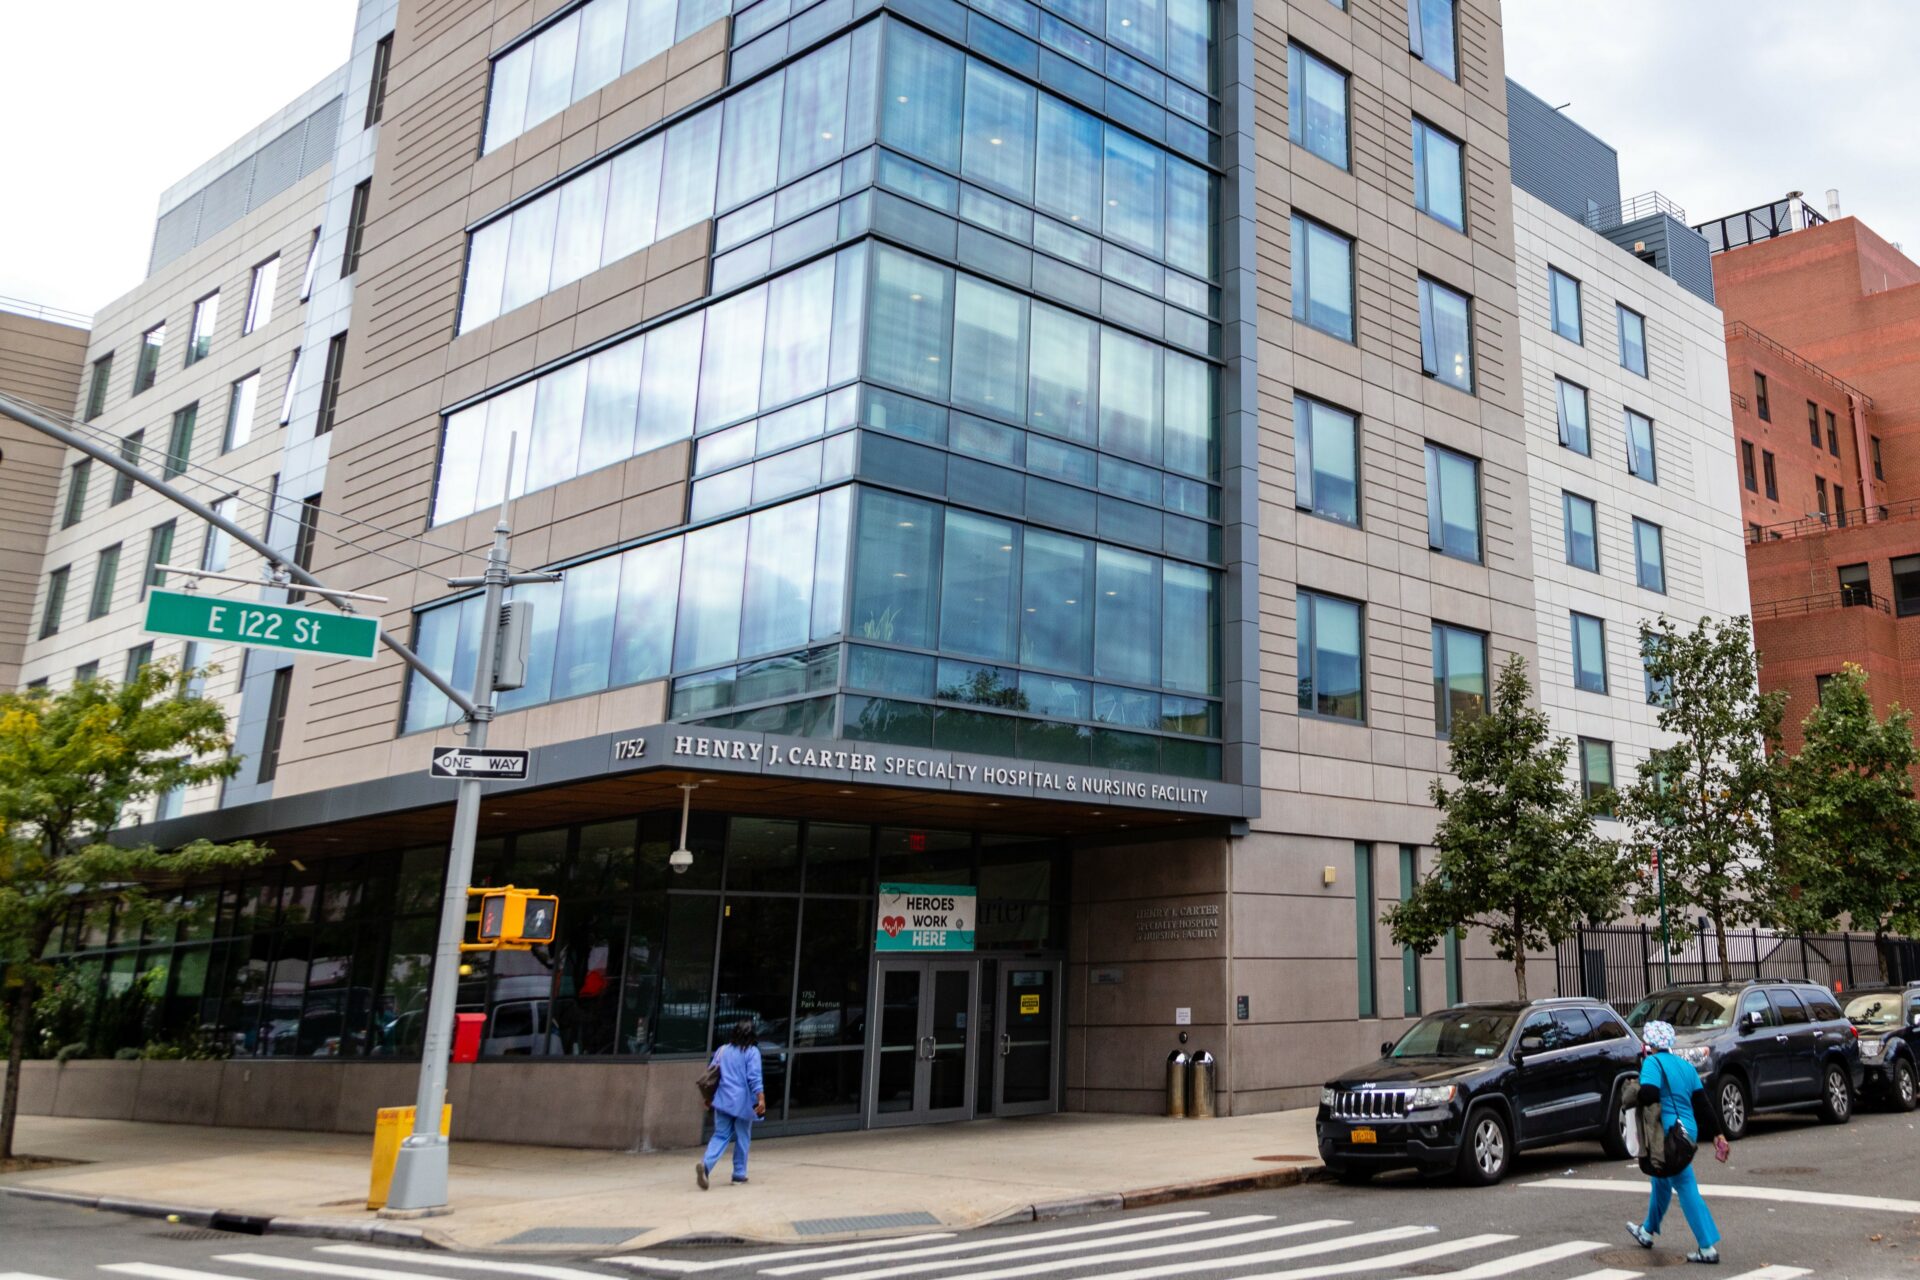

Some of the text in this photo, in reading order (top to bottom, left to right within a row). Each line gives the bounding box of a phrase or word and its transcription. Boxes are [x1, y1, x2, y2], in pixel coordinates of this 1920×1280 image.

[208, 606, 322, 645] E 122 St
[615, 738, 645, 760] 1752
[442, 756, 520, 770] ONE WAY
[675, 736, 1209, 804] HENRY J. CARTER SPECIALTY HOSPITAL & NURSING FACILITY
[906, 897, 955, 911] HEROES
[1180, 905, 1219, 916] CARTER
[912, 915, 948, 927] WORK
[1179, 918, 1217, 929] HOSPITAL
[912, 931, 947, 946] HERE
[1183, 928, 1217, 939] FACILITY
[801, 990, 816, 999] 1752
[800, 1000, 815, 1008] Park
[1362, 1082, 1377, 1090] Jeep
